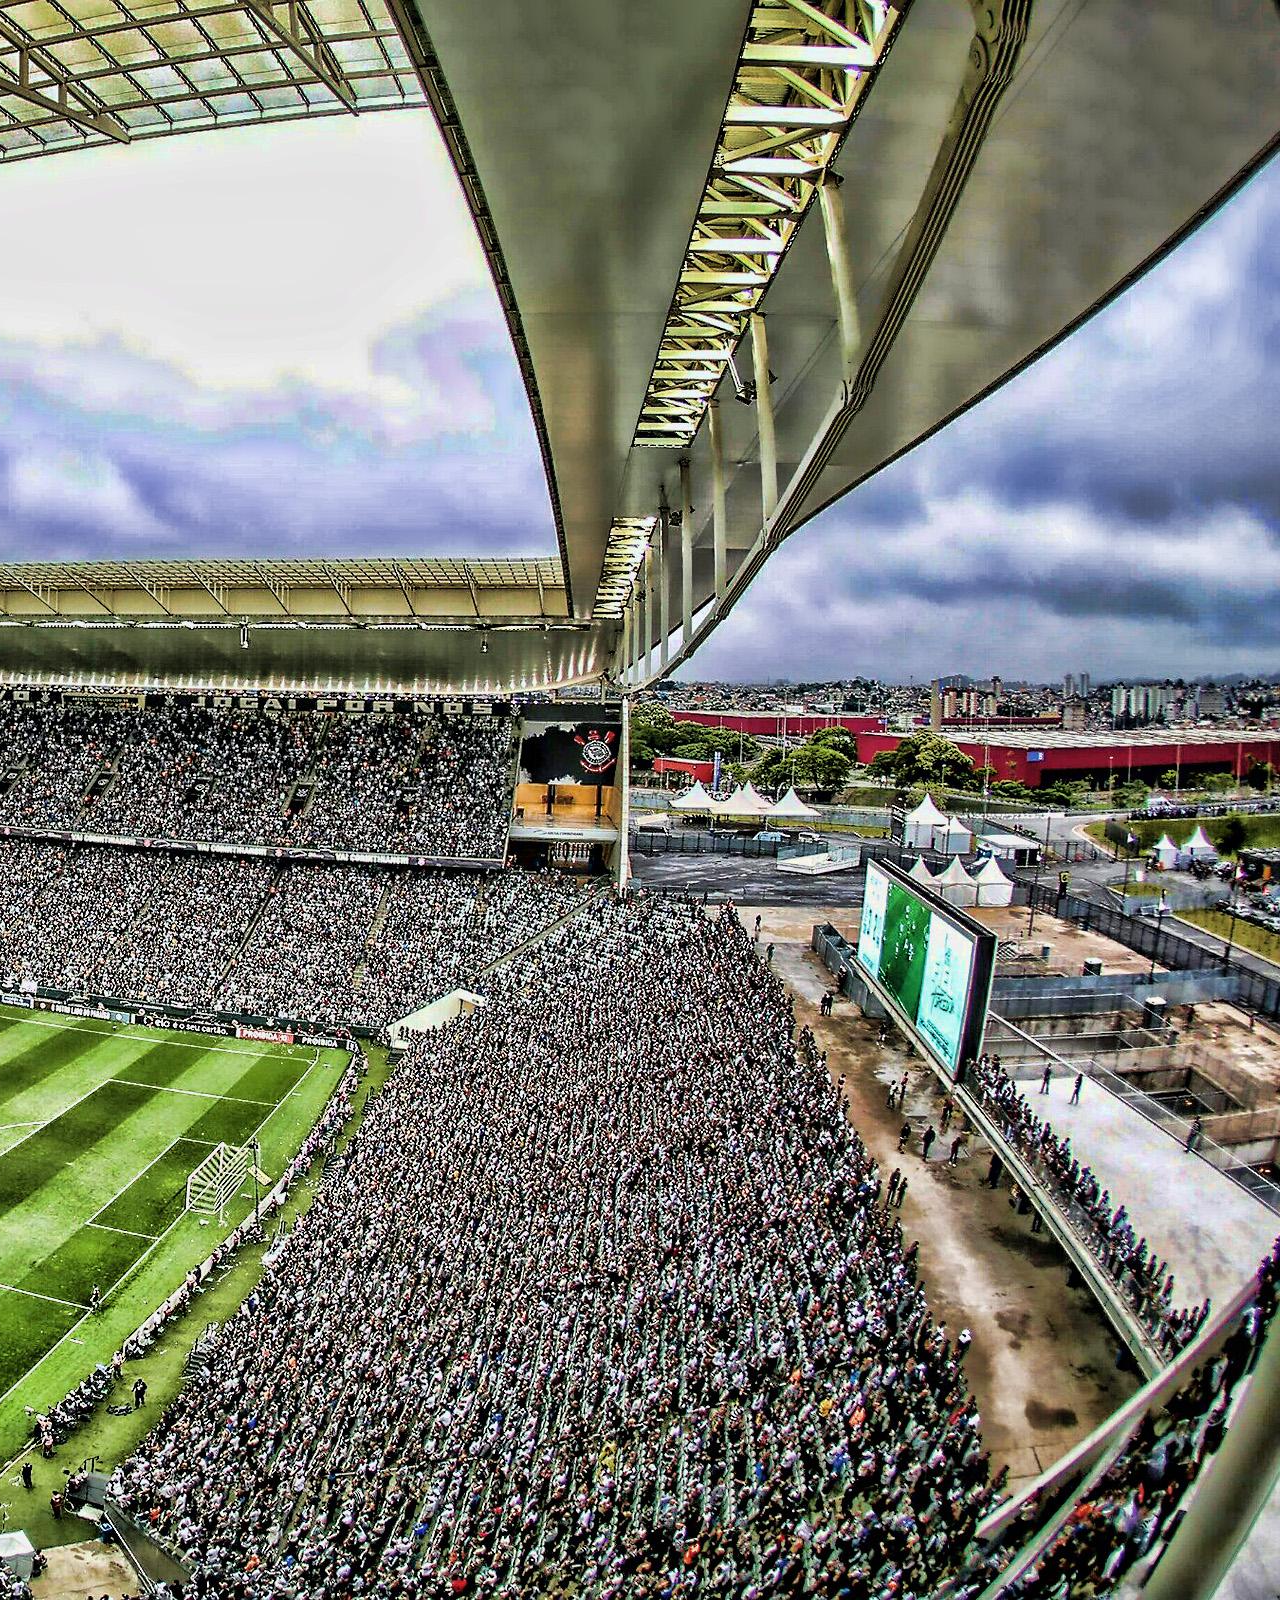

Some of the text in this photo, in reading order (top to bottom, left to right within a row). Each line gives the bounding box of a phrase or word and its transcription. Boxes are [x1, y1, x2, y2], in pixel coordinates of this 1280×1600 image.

[191, 696, 297, 710] JOGAI
[316, 699, 394, 713] POR
[301, 1036, 338, 1048] PROIBIDA
